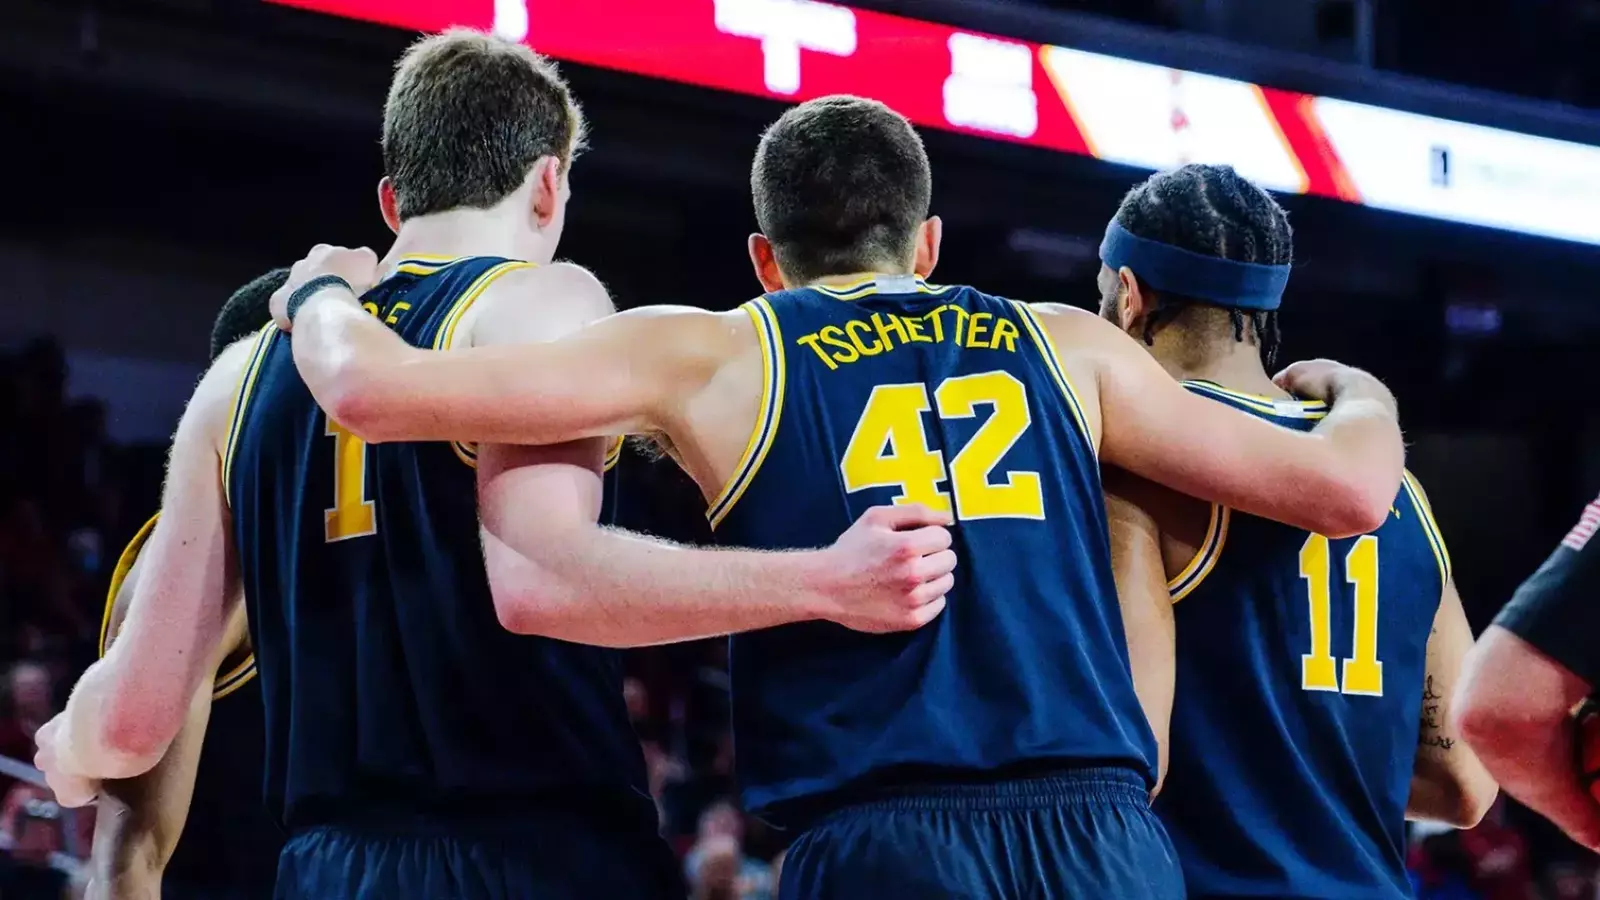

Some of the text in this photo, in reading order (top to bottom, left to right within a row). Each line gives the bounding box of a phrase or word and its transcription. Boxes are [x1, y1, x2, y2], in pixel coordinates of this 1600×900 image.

[797, 304, 1020, 370] TSCHETTER
[324, 413, 377, 543] 1
[840, 370, 1046, 525] 42
[1299, 532, 1384, 697] 11
